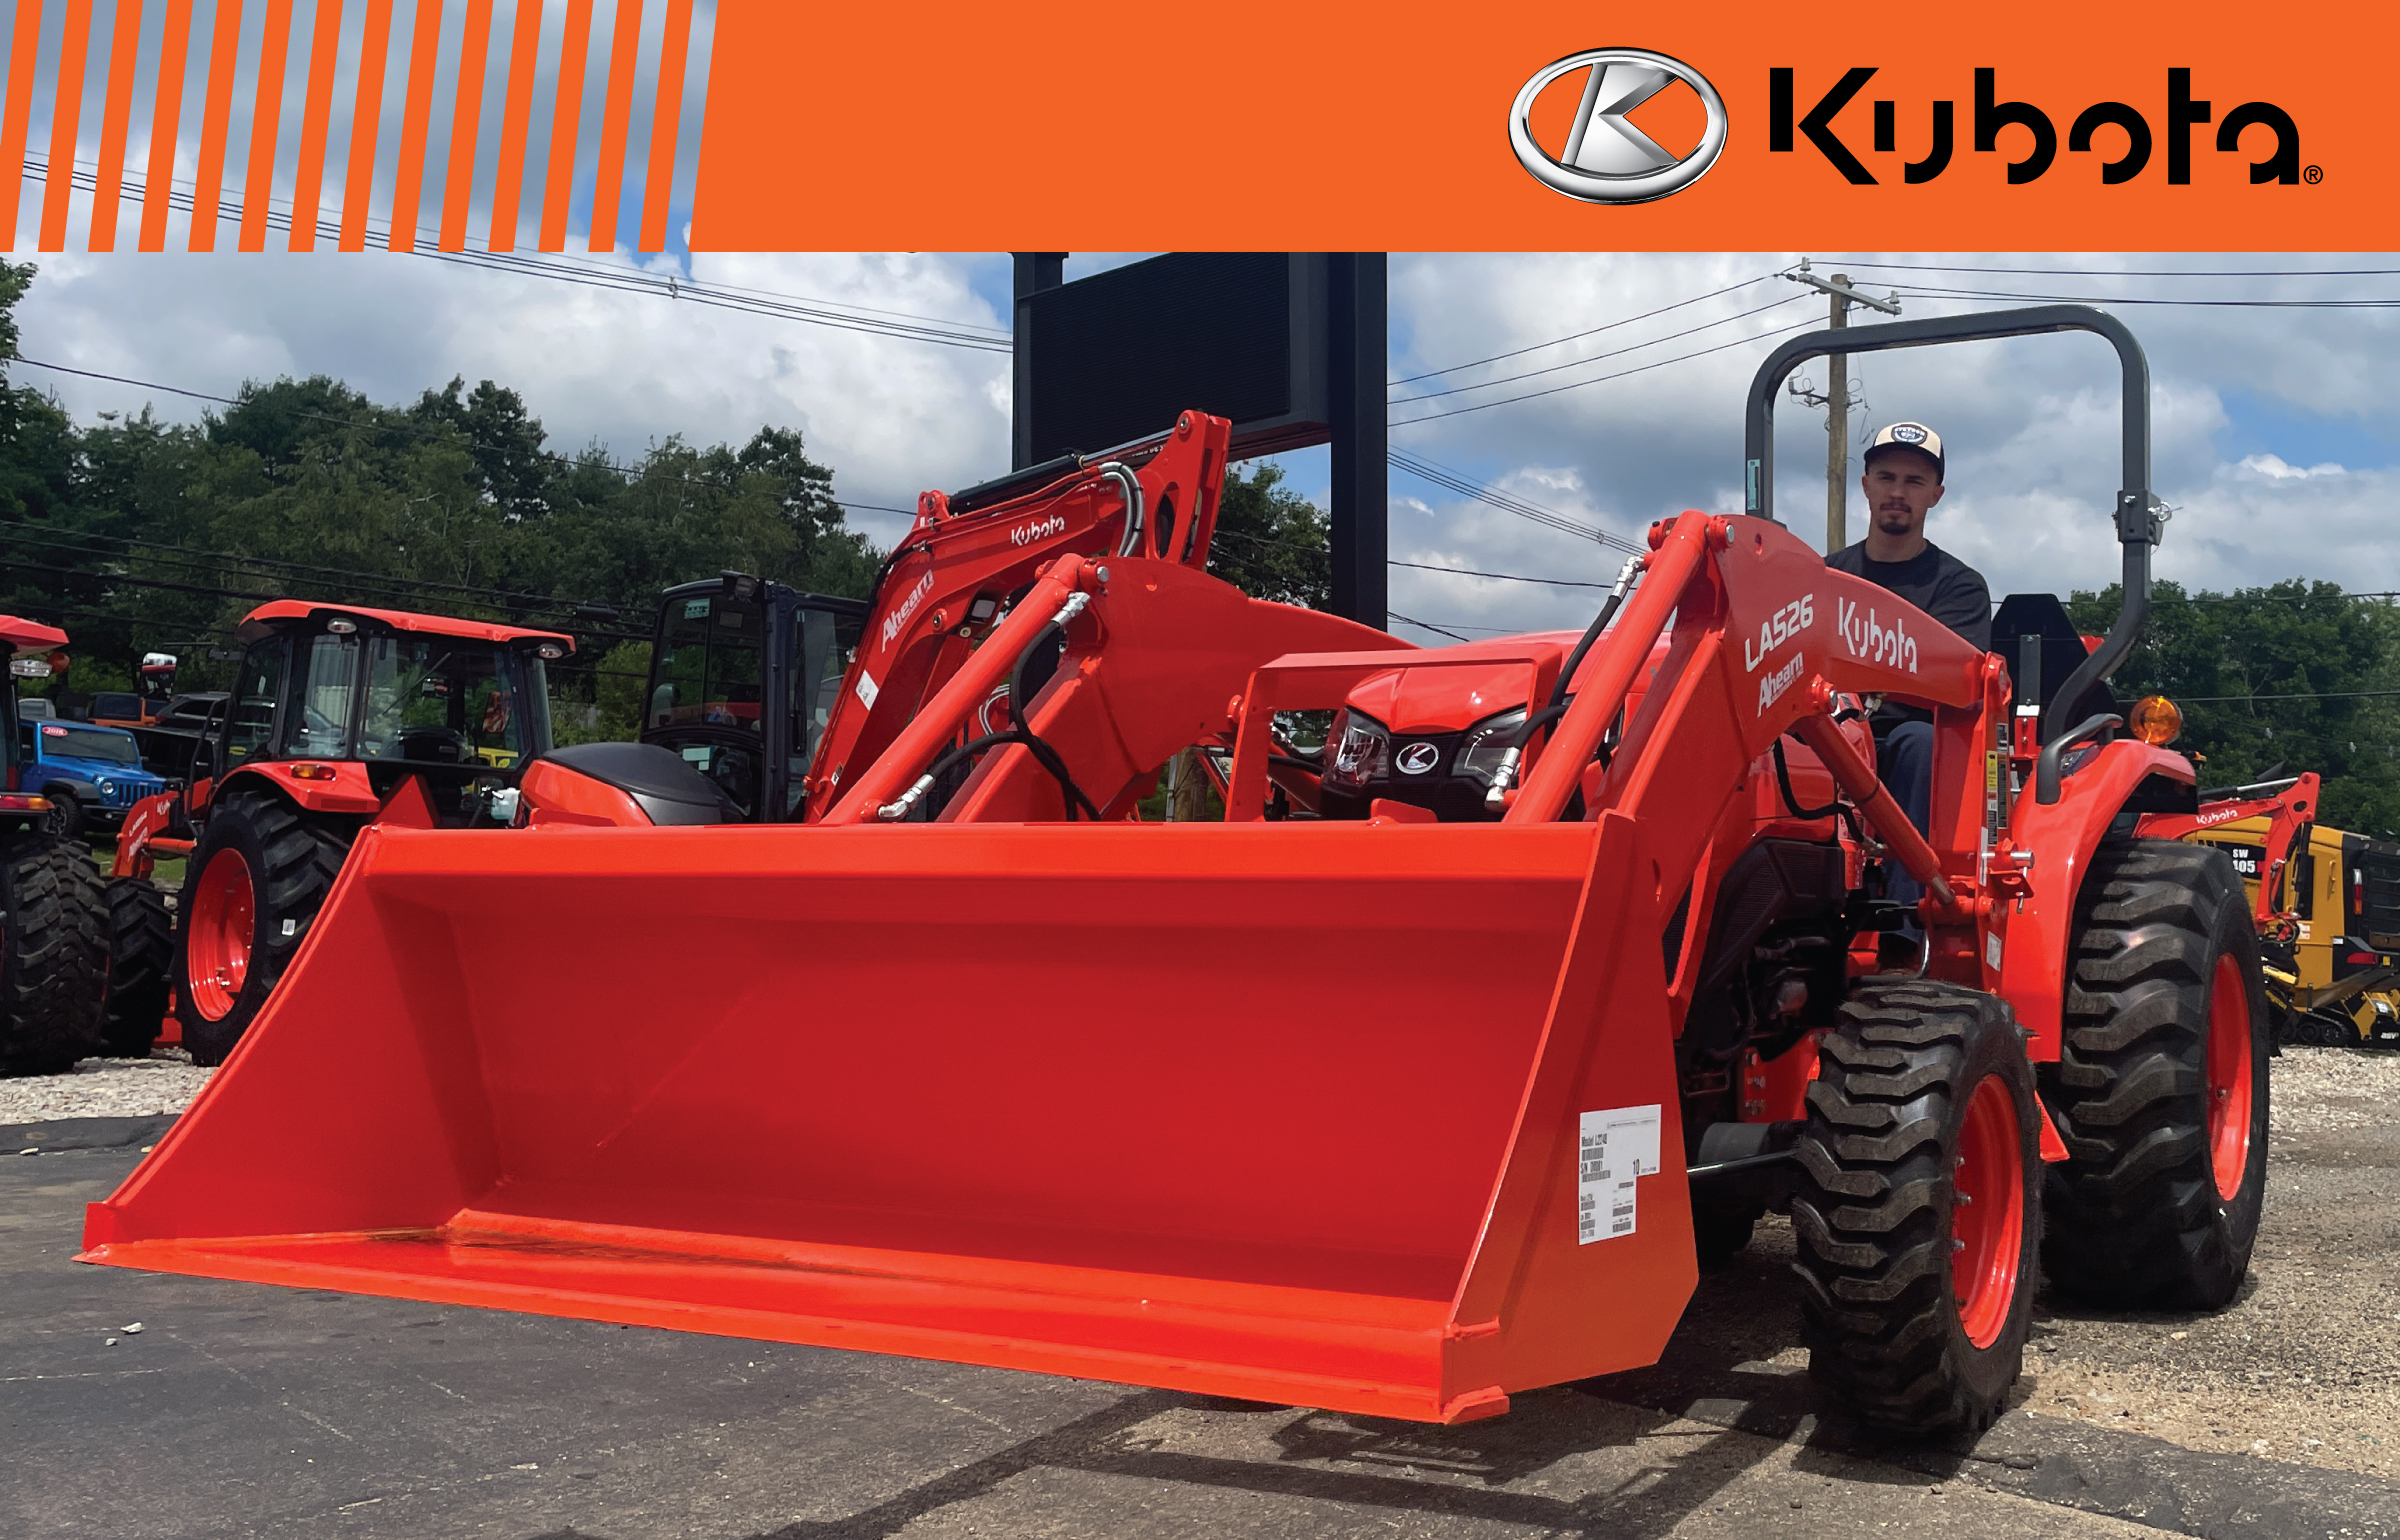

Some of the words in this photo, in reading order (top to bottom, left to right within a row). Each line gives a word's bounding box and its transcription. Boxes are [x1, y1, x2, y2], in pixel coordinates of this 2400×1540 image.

[1011, 514, 1065, 546] Kubota
[882, 569, 934, 653] Ahearn
[1744, 593, 1813, 672] LA526
[1838, 596, 1917, 674] Kubota
[1757, 652, 1803, 718] Ahearn
[2196, 809, 2238, 824] Kubota
[2232, 848, 2249, 858] SW
